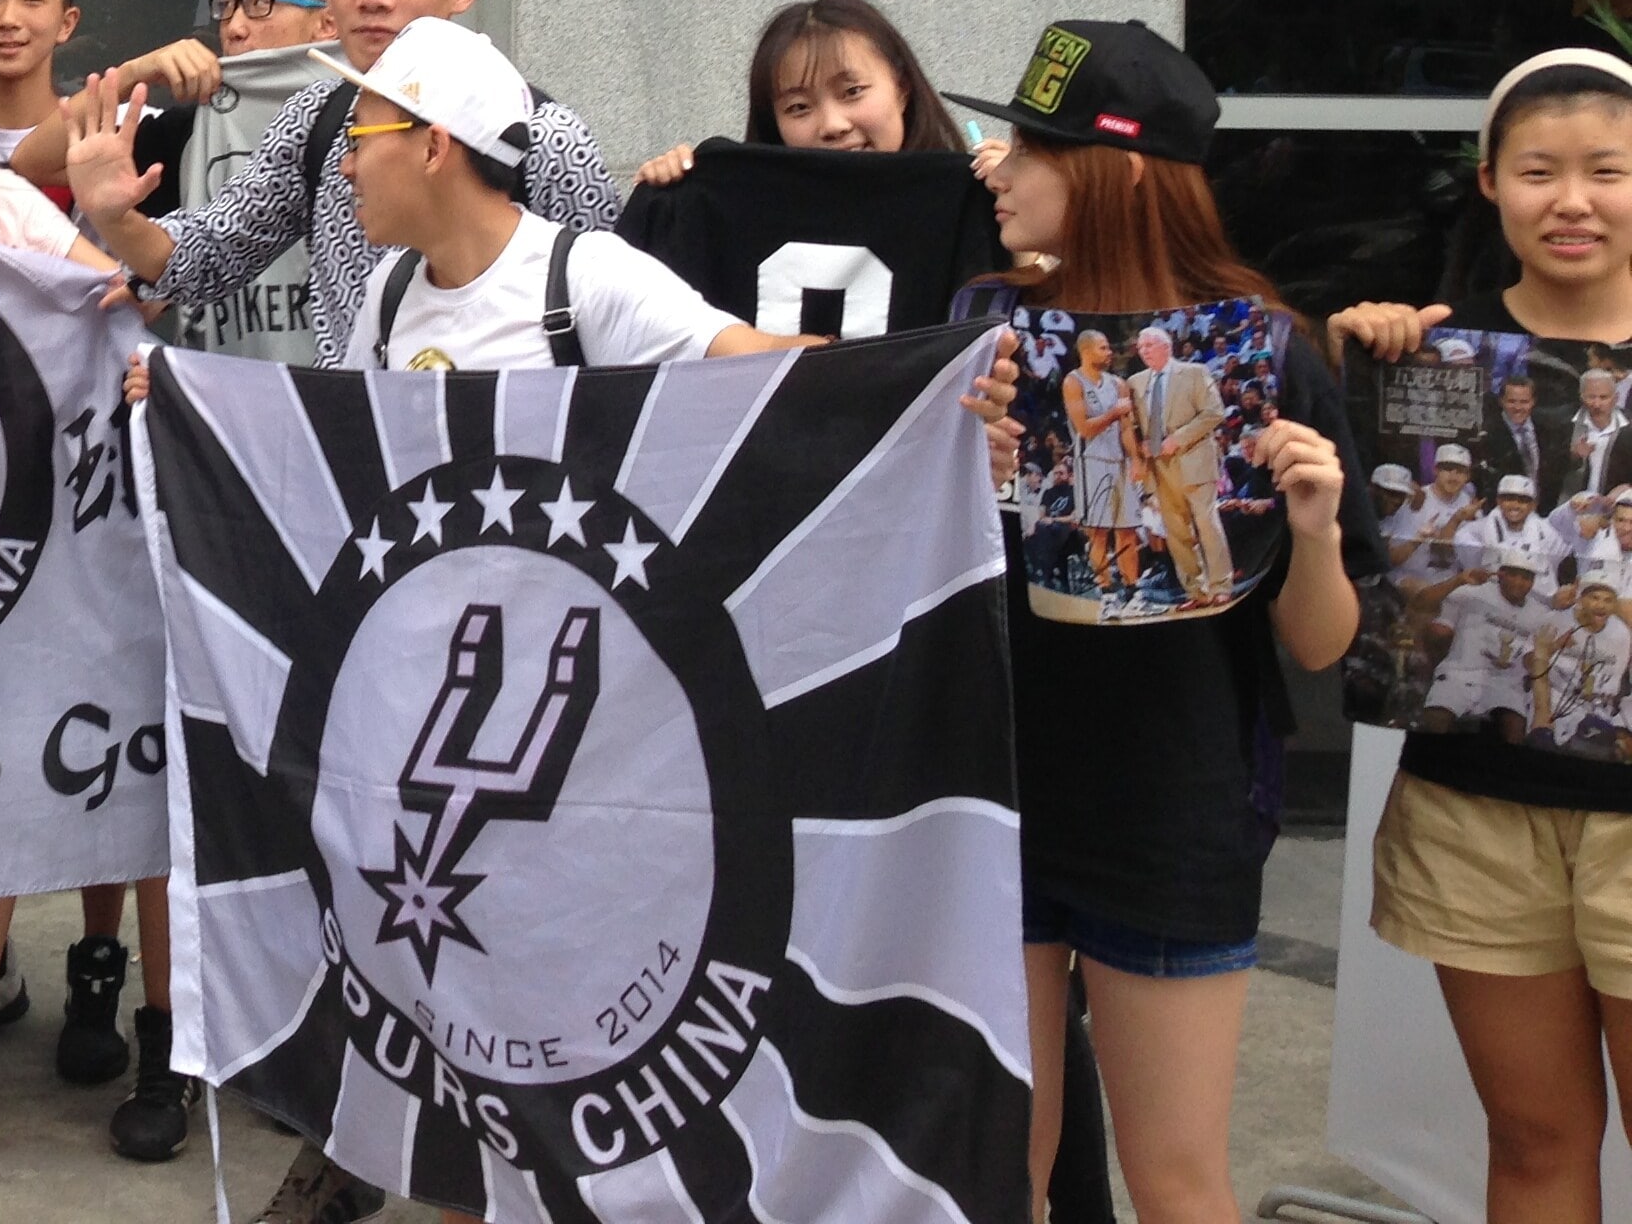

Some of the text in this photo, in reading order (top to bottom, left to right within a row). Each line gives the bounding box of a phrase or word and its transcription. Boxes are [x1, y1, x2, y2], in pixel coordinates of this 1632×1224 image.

[42, 702, 167, 813] Go
[319, 906, 773, 1166] SPURS CHINA
[413, 939, 682, 1069] SINCE 2014
